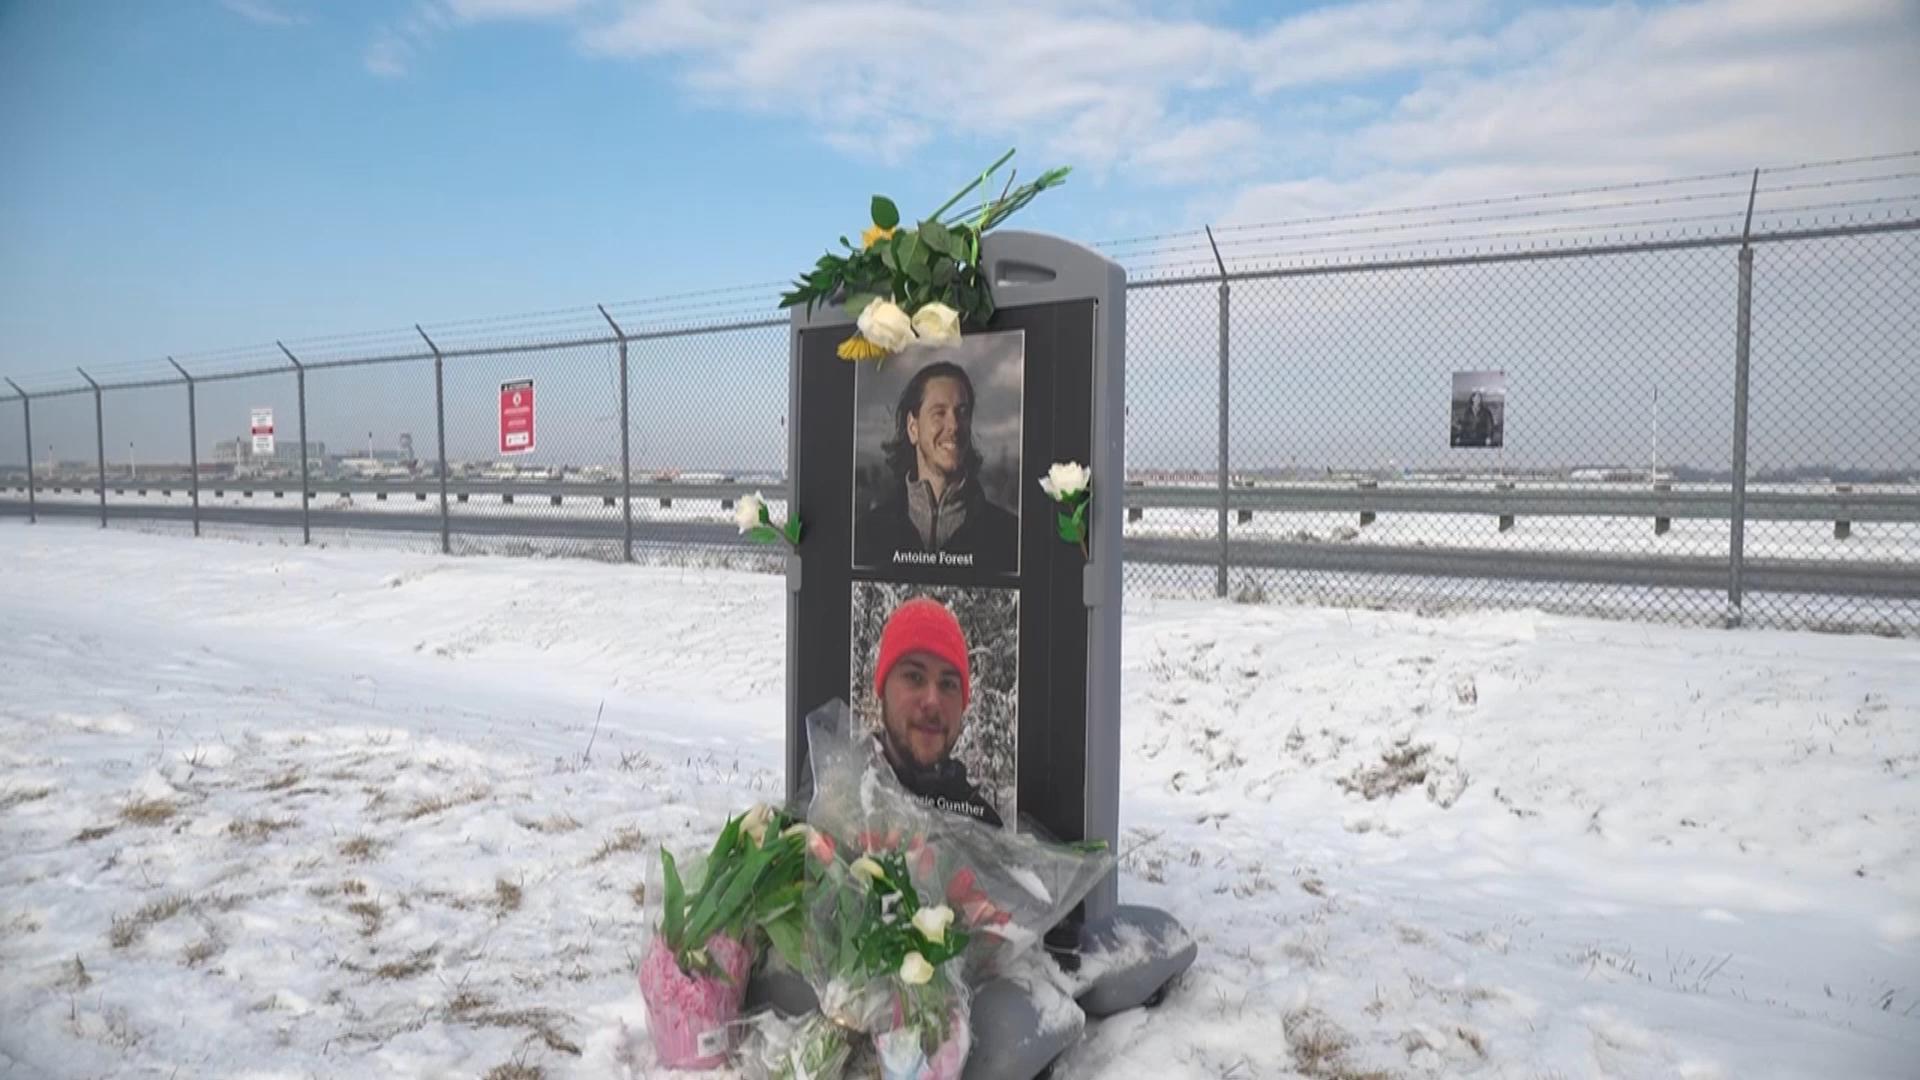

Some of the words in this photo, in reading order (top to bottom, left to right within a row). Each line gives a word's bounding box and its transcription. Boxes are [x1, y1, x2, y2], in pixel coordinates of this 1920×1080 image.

[893, 550, 937, 564] Antoine
[939, 551, 973, 565] Forest
[937, 797, 984, 816] Gunther
